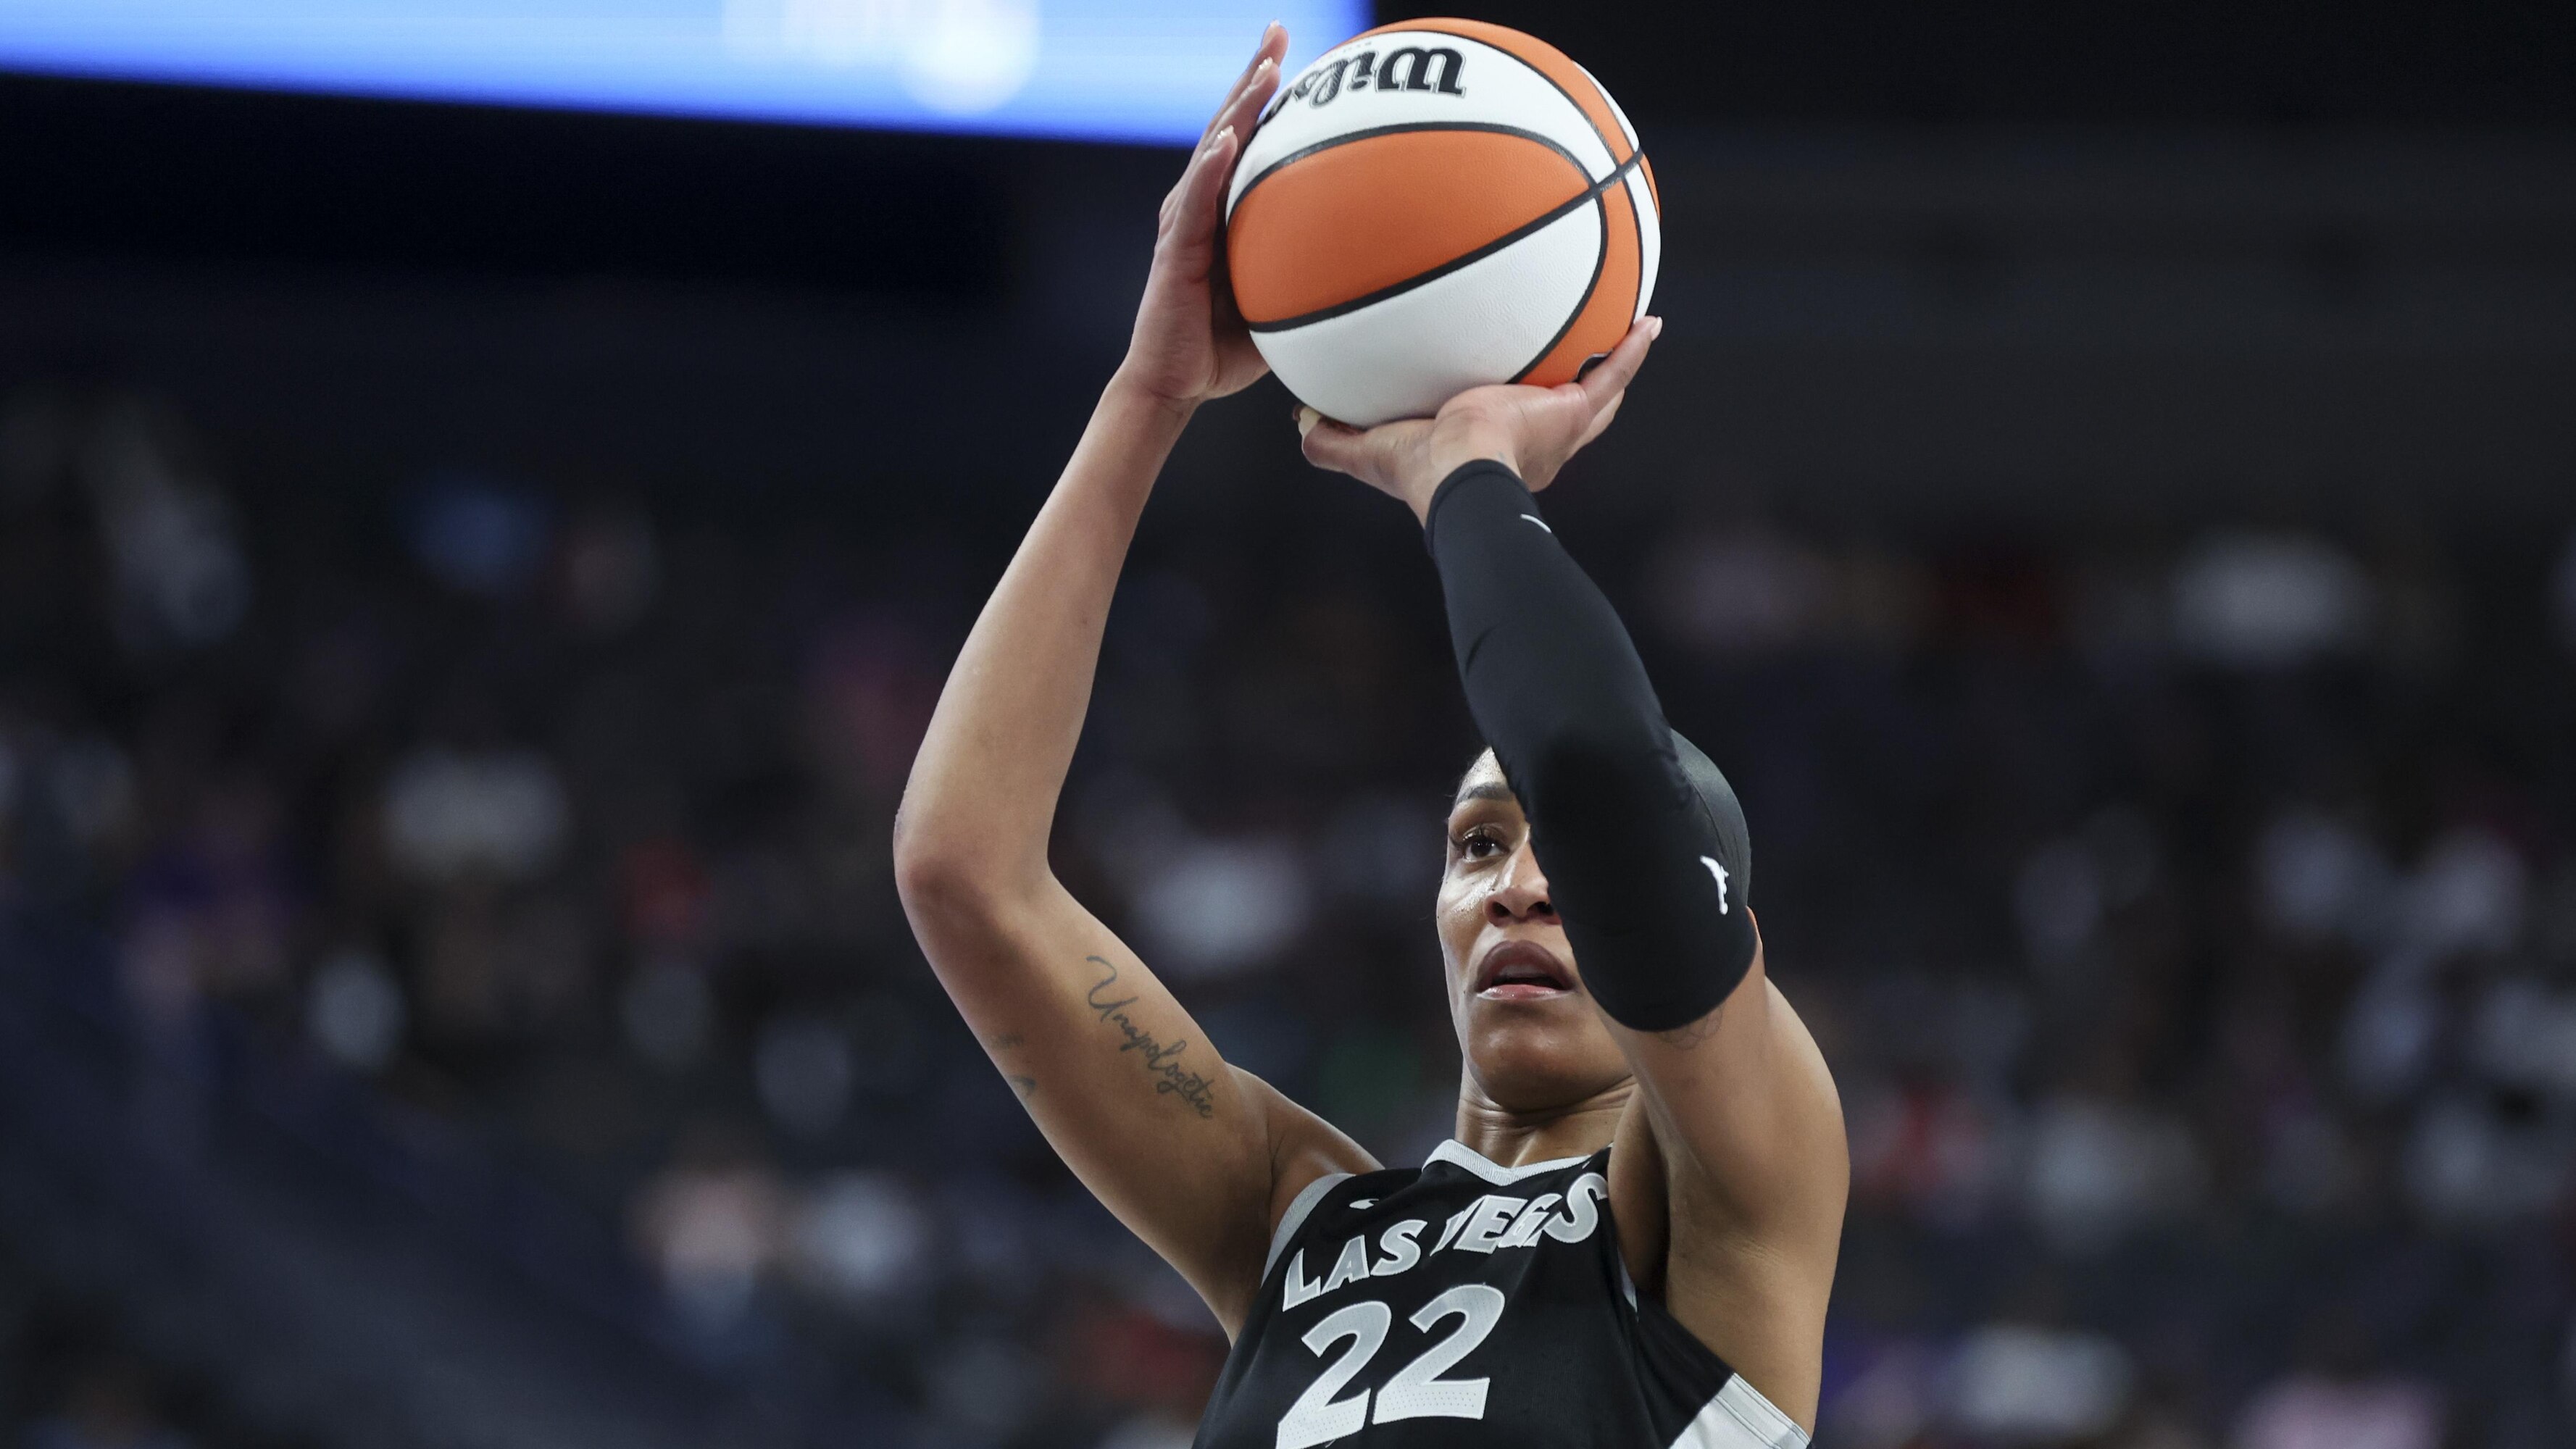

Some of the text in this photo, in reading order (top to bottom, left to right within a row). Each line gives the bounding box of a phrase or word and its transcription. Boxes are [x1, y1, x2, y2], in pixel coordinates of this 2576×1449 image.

[1262, 46, 1467, 125] Wils
[1283, 1219, 1427, 1311] LAS
[1275, 1284, 1505, 1449] 22
